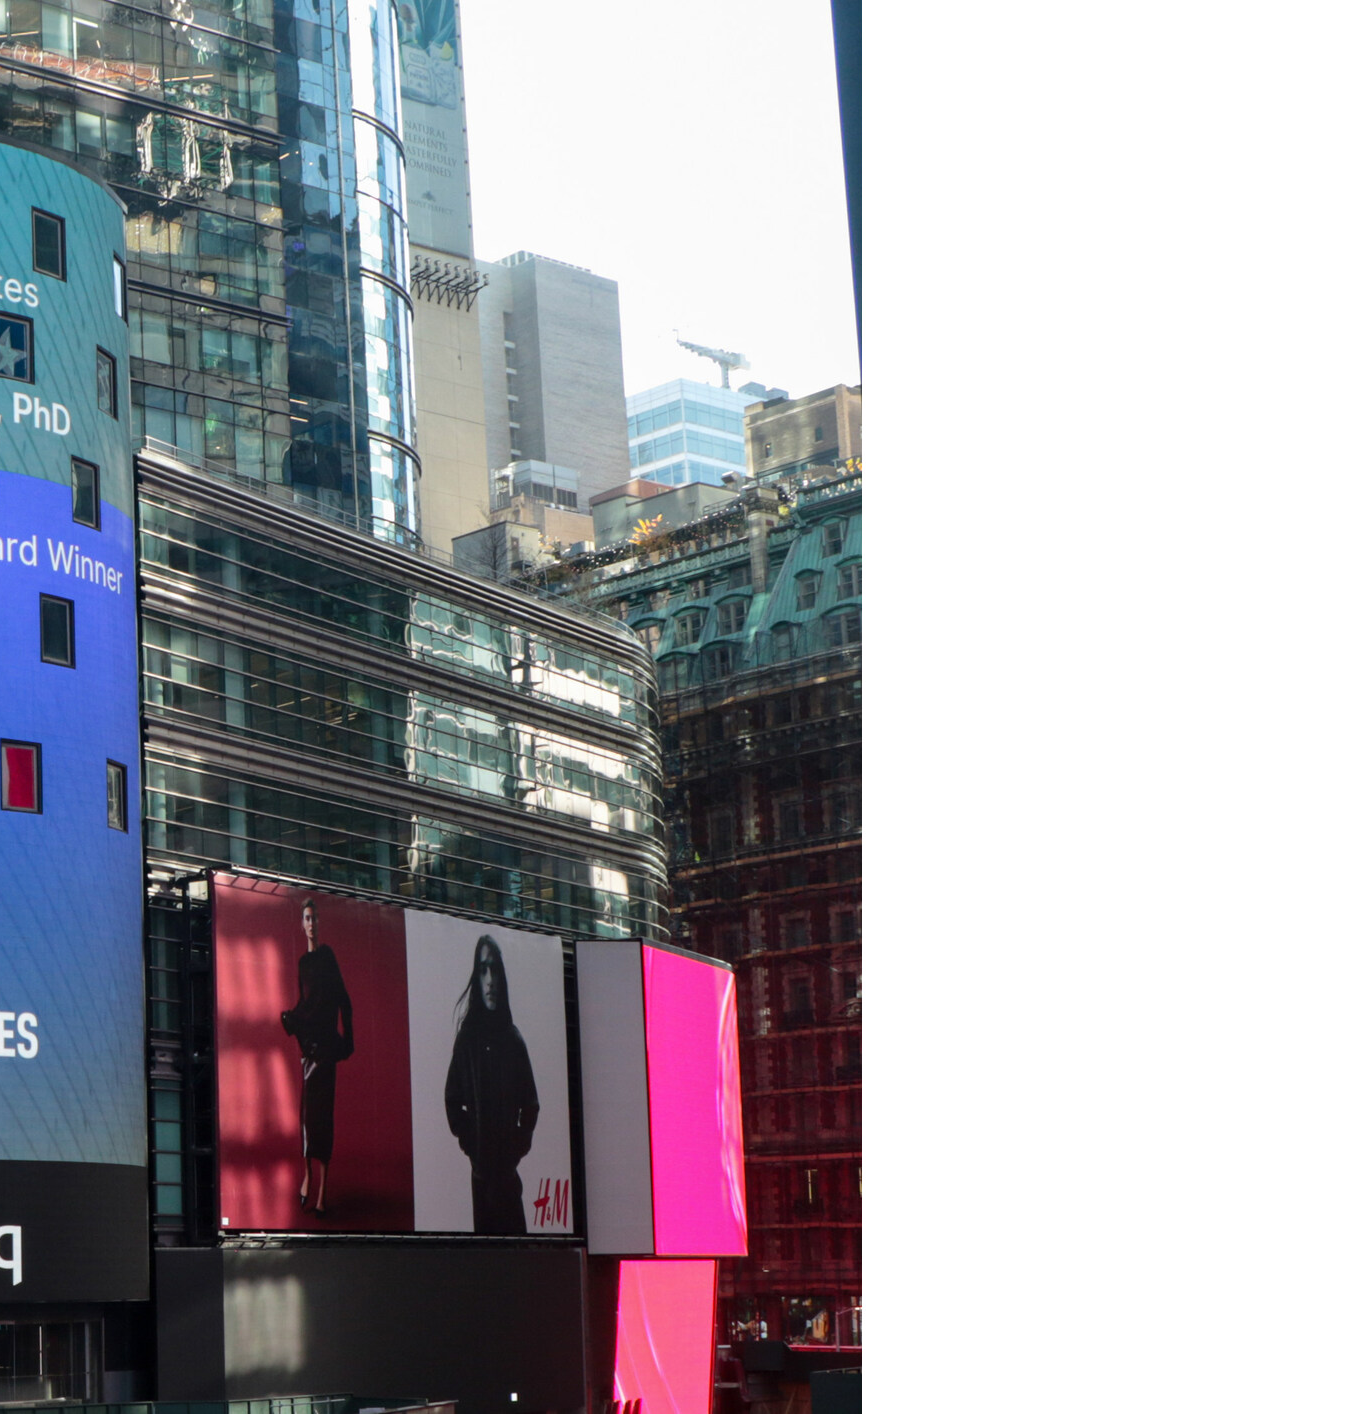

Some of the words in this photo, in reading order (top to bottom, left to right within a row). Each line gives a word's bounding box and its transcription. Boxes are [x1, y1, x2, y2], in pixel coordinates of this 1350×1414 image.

[405, 121, 447, 140] NATURAL
[405, 132, 448, 152] ELEMENTS
[407, 157, 452, 177] OMBINED
[13, 391, 71, 436] PhD
[47, 538, 123, 594] Winner
[533, 1177, 569, 1229] H&M
